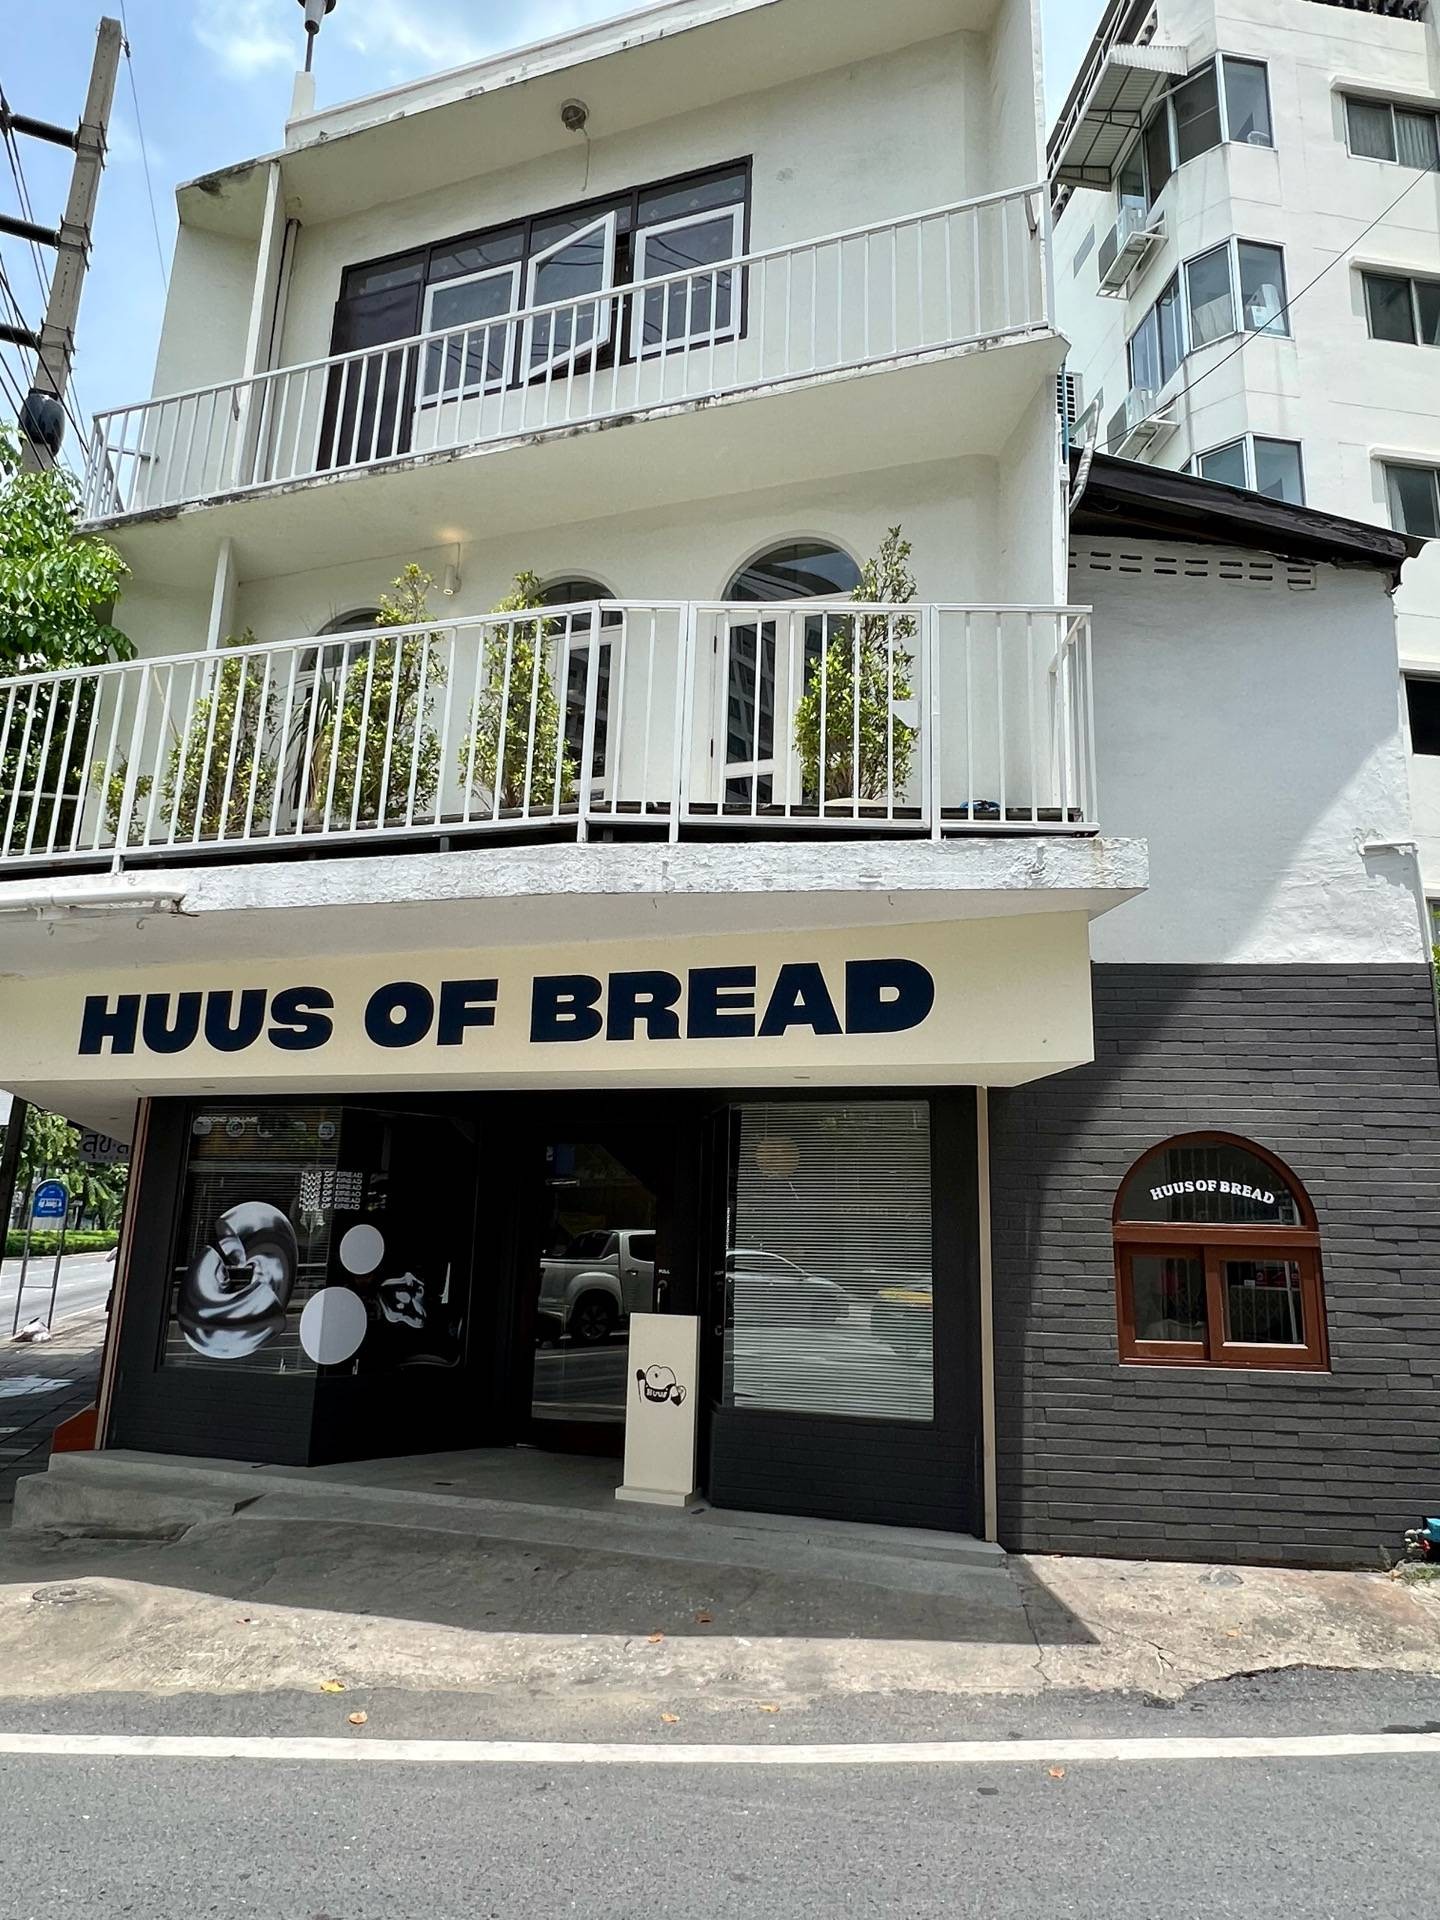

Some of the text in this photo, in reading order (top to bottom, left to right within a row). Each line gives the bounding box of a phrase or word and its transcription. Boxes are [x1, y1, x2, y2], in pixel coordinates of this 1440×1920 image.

[78, 958, 935, 1056] HUUS OF BREAD
[1150, 1180, 1275, 1204] HUUS OF BREAD
